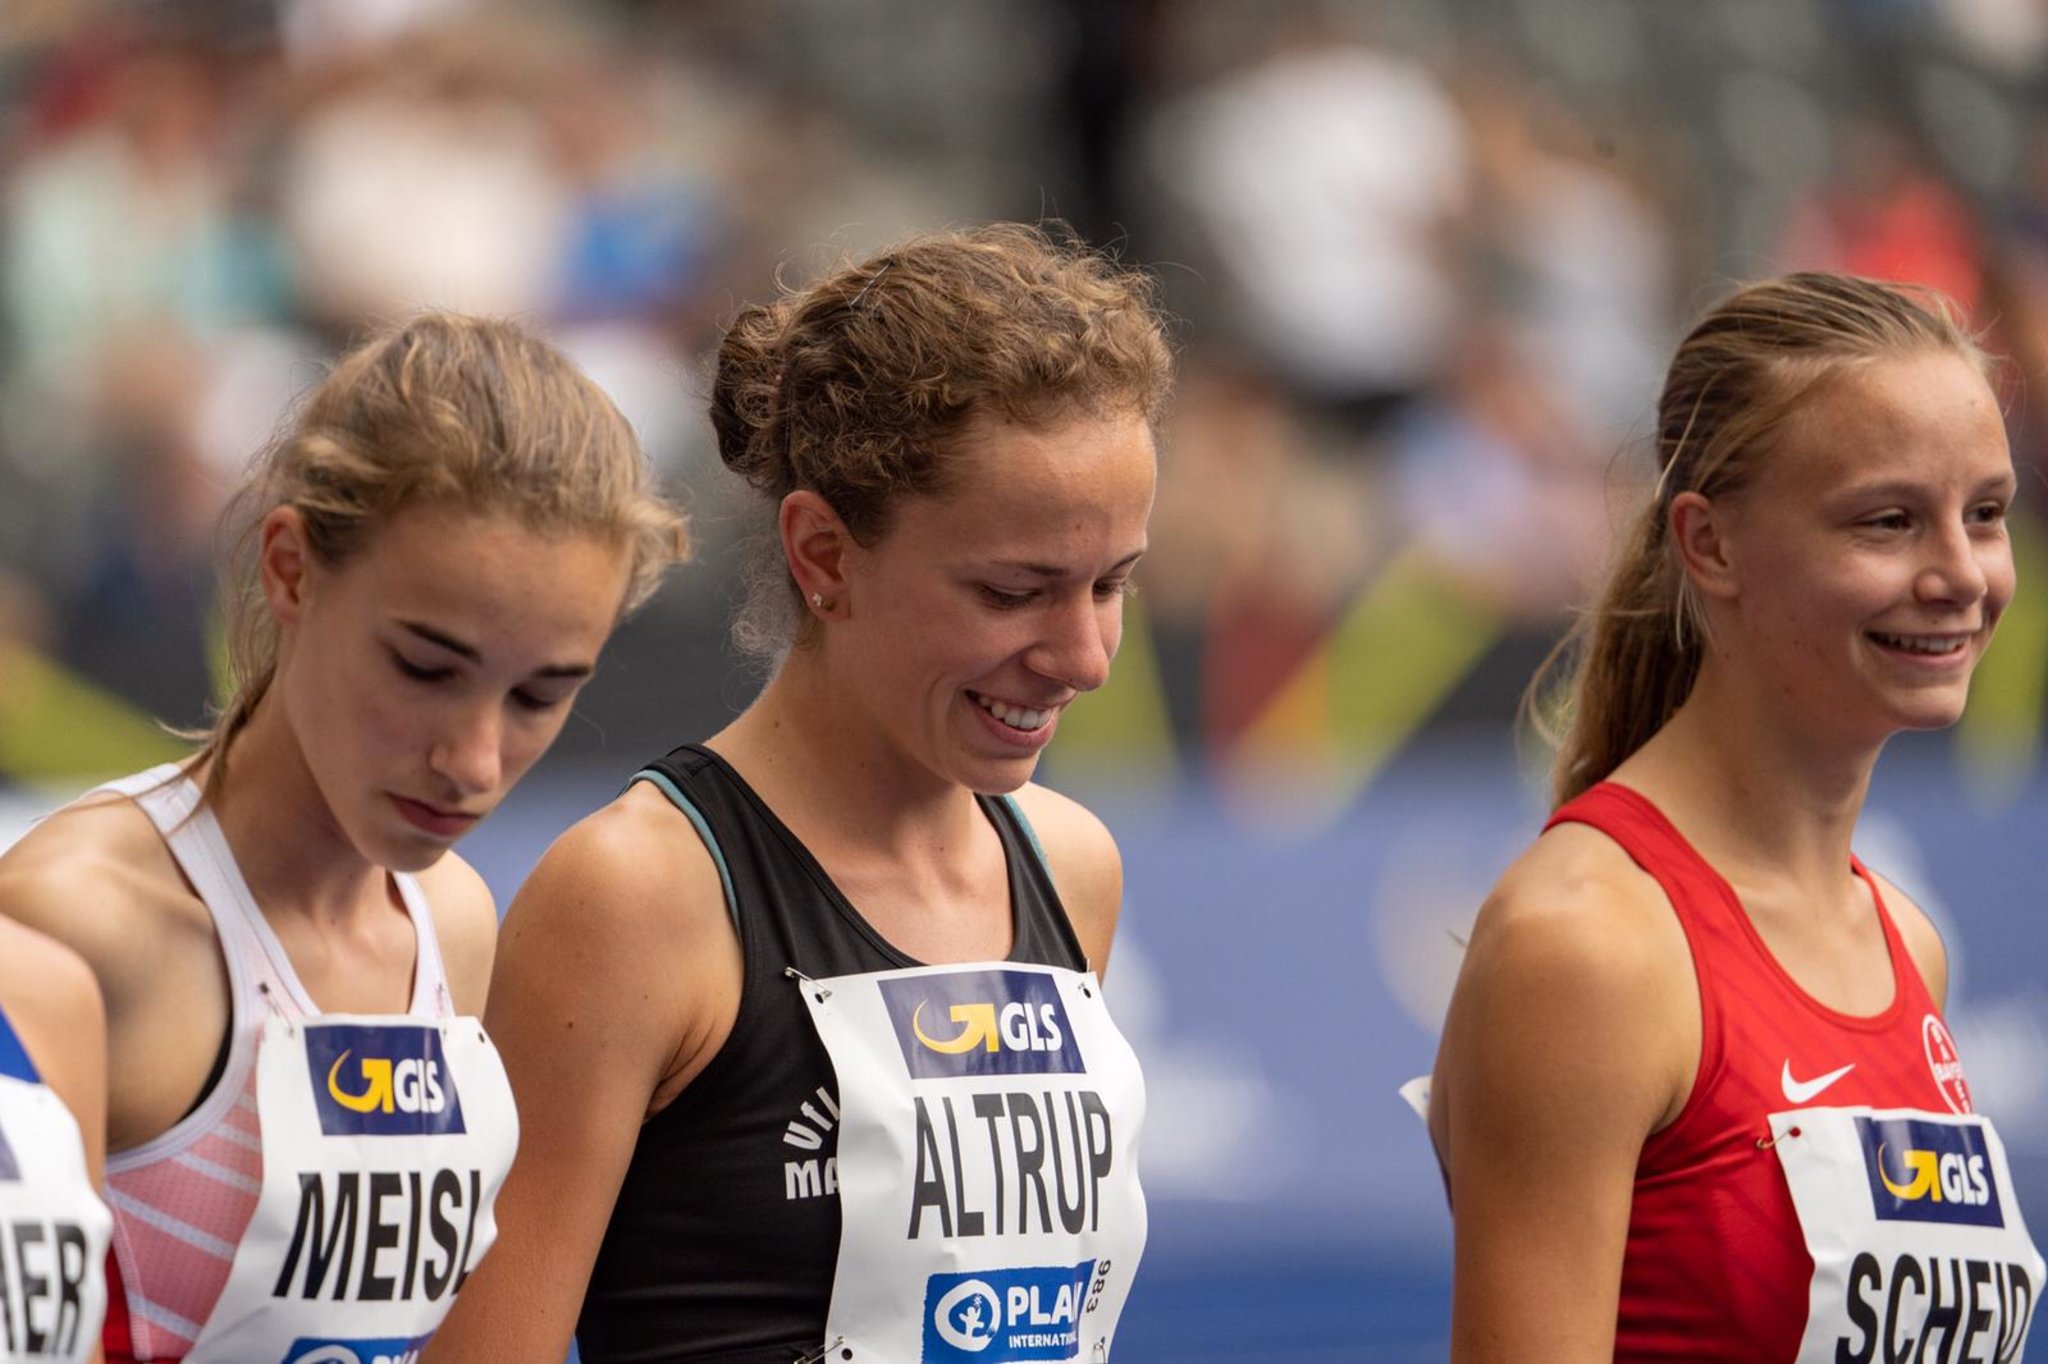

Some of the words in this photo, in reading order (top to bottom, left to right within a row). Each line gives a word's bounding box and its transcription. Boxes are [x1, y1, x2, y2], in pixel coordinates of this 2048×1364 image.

[999, 1001, 1064, 1053] GLS
[393, 1058, 445, 1114] GLS
[906, 1090, 1113, 1240] ALTRUP
[1939, 1152, 1990, 1206] GLS
[0, 1222, 87, 1357] ER
[1086, 1260, 1112, 1314] 983
[1834, 1251, 2032, 1364] SCHEID
